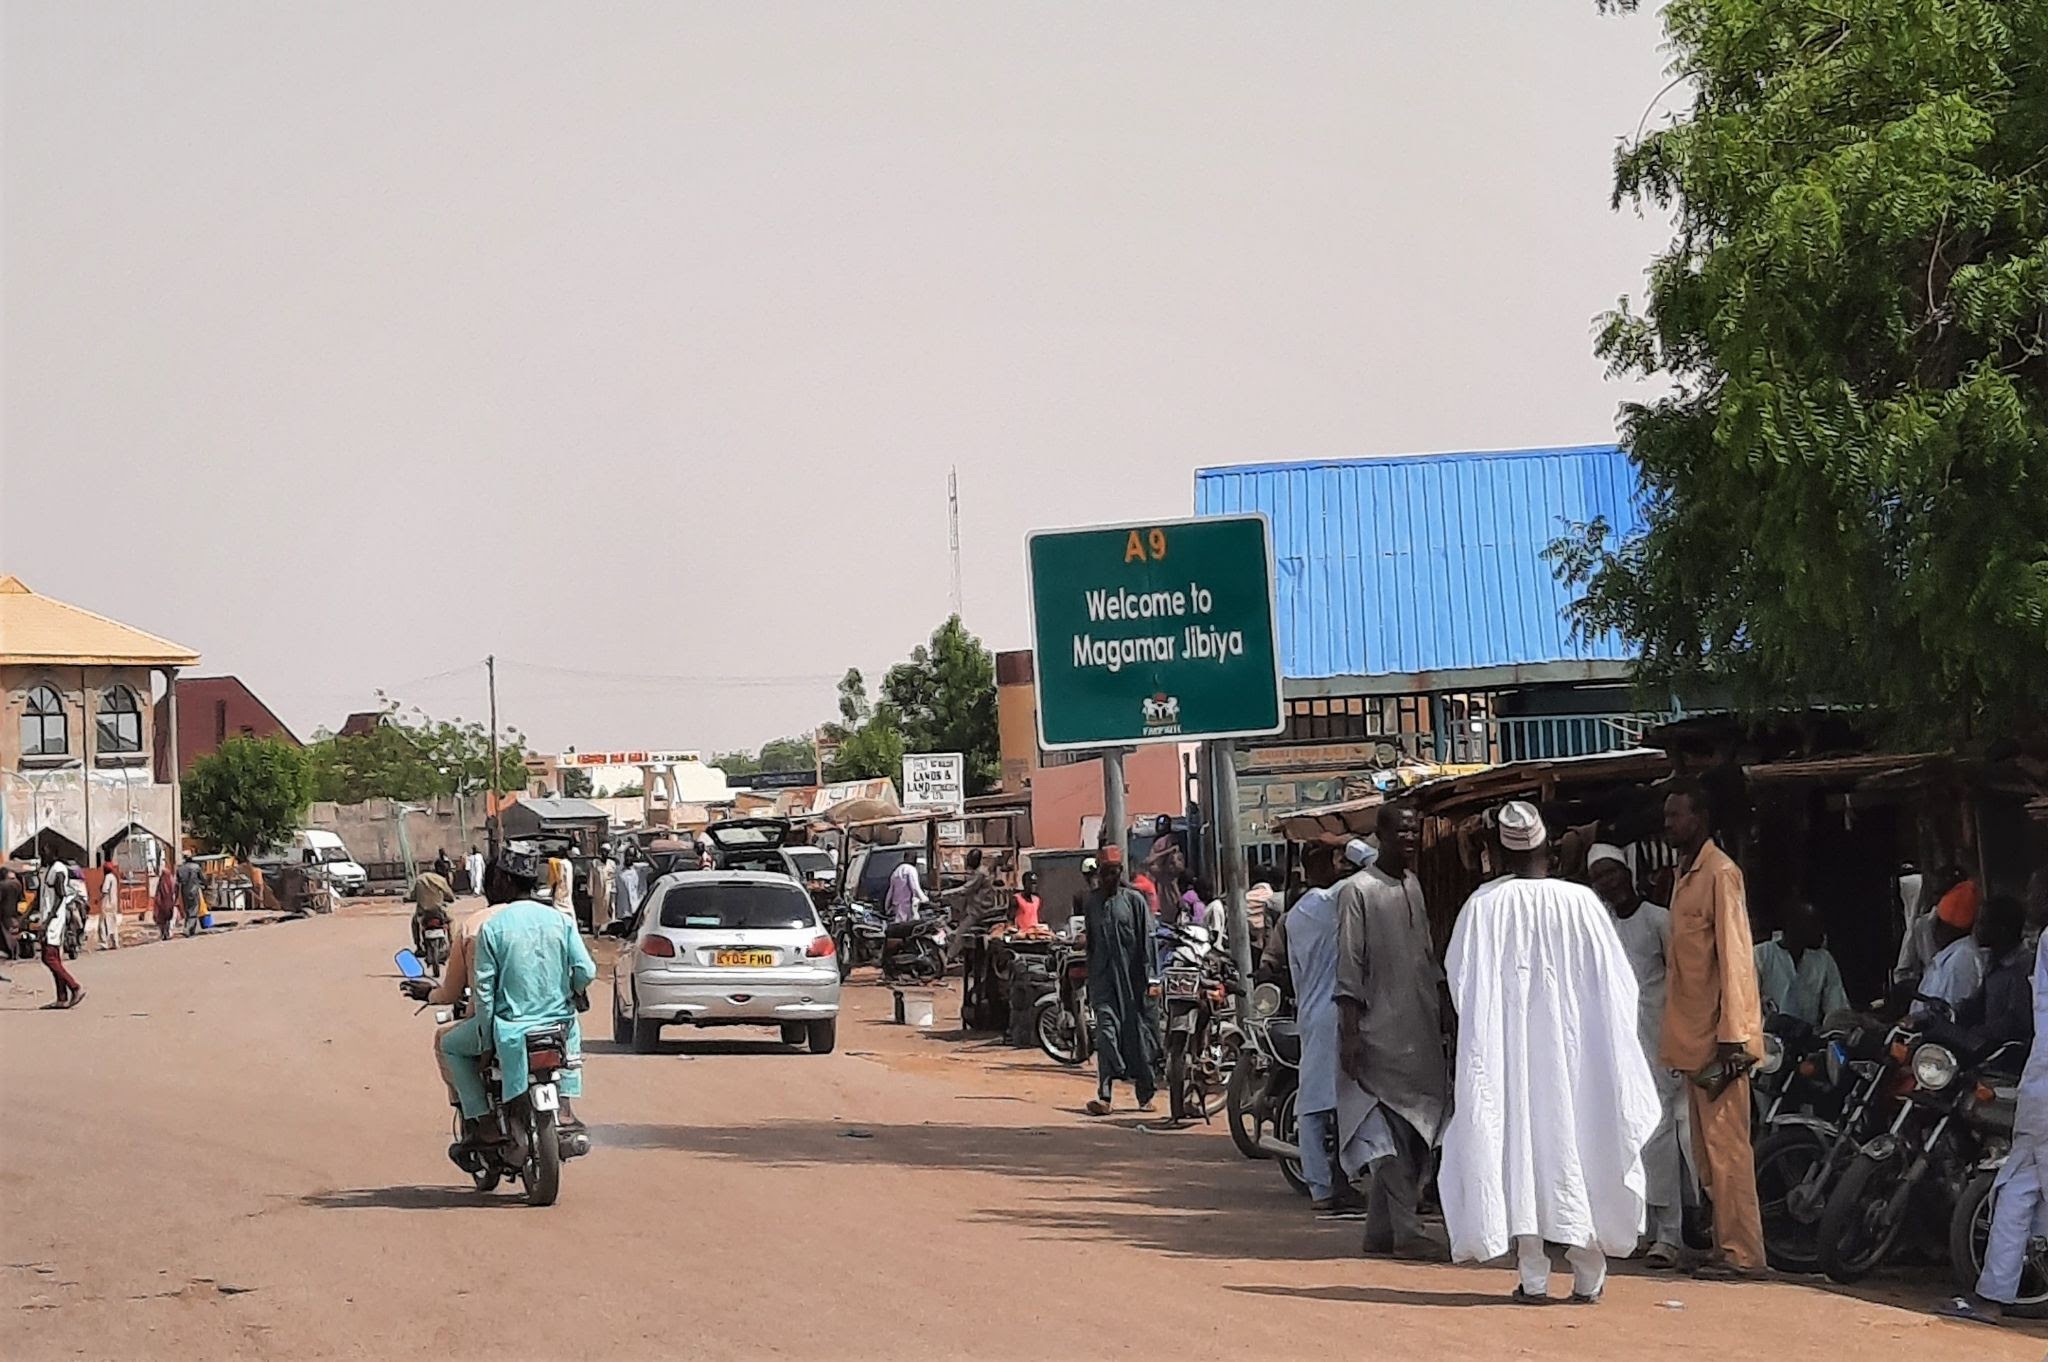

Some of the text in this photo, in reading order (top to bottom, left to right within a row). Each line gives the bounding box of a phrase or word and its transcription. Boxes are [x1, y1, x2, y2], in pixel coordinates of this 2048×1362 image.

[1124, 528, 1167, 563] A9
[1085, 582, 1213, 622] Welcome to
[1072, 624, 1243, 673] Magamar Jibiya
